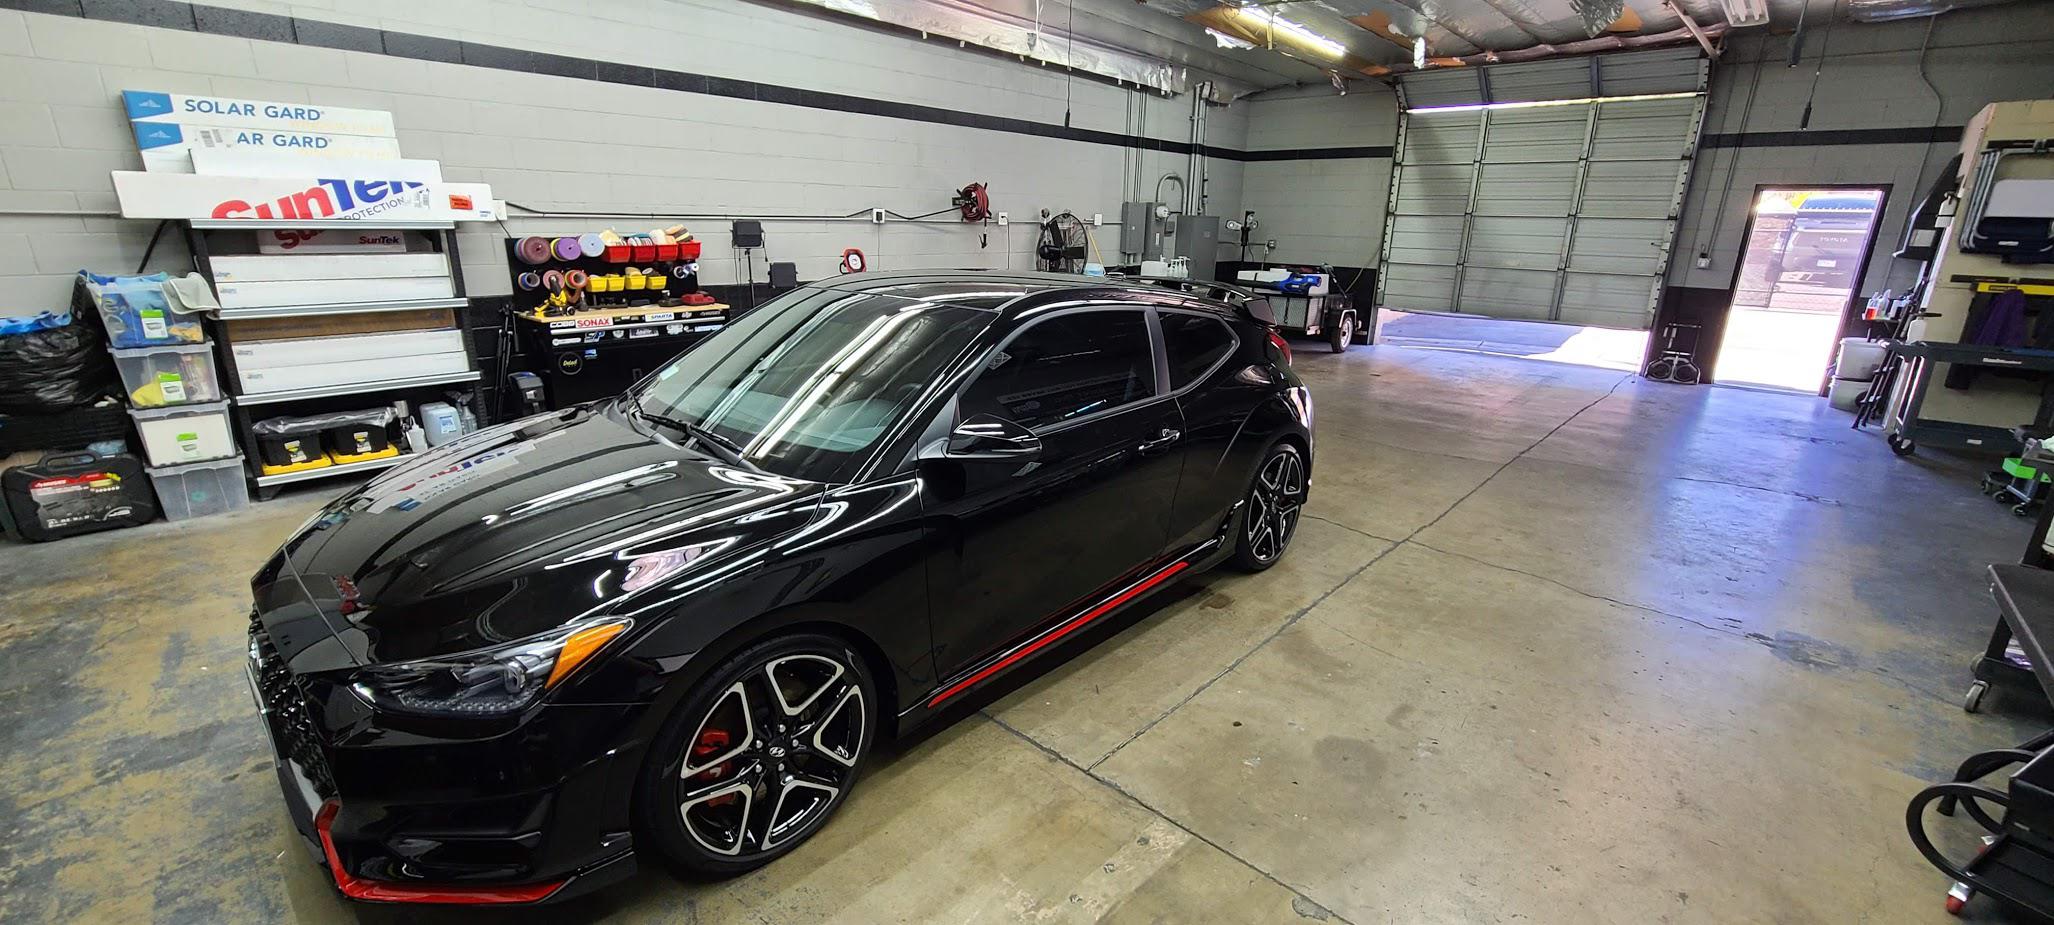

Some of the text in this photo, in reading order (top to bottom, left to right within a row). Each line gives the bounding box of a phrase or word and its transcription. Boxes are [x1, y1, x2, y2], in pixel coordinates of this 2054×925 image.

[184, 99, 321, 121] SOLAR GARD
[272, 134, 328, 149] GARD
[339, 196, 405, 220] ROTECTION
[359, 235, 401, 245] SunTek
[577, 318, 610, 328] SONAX
